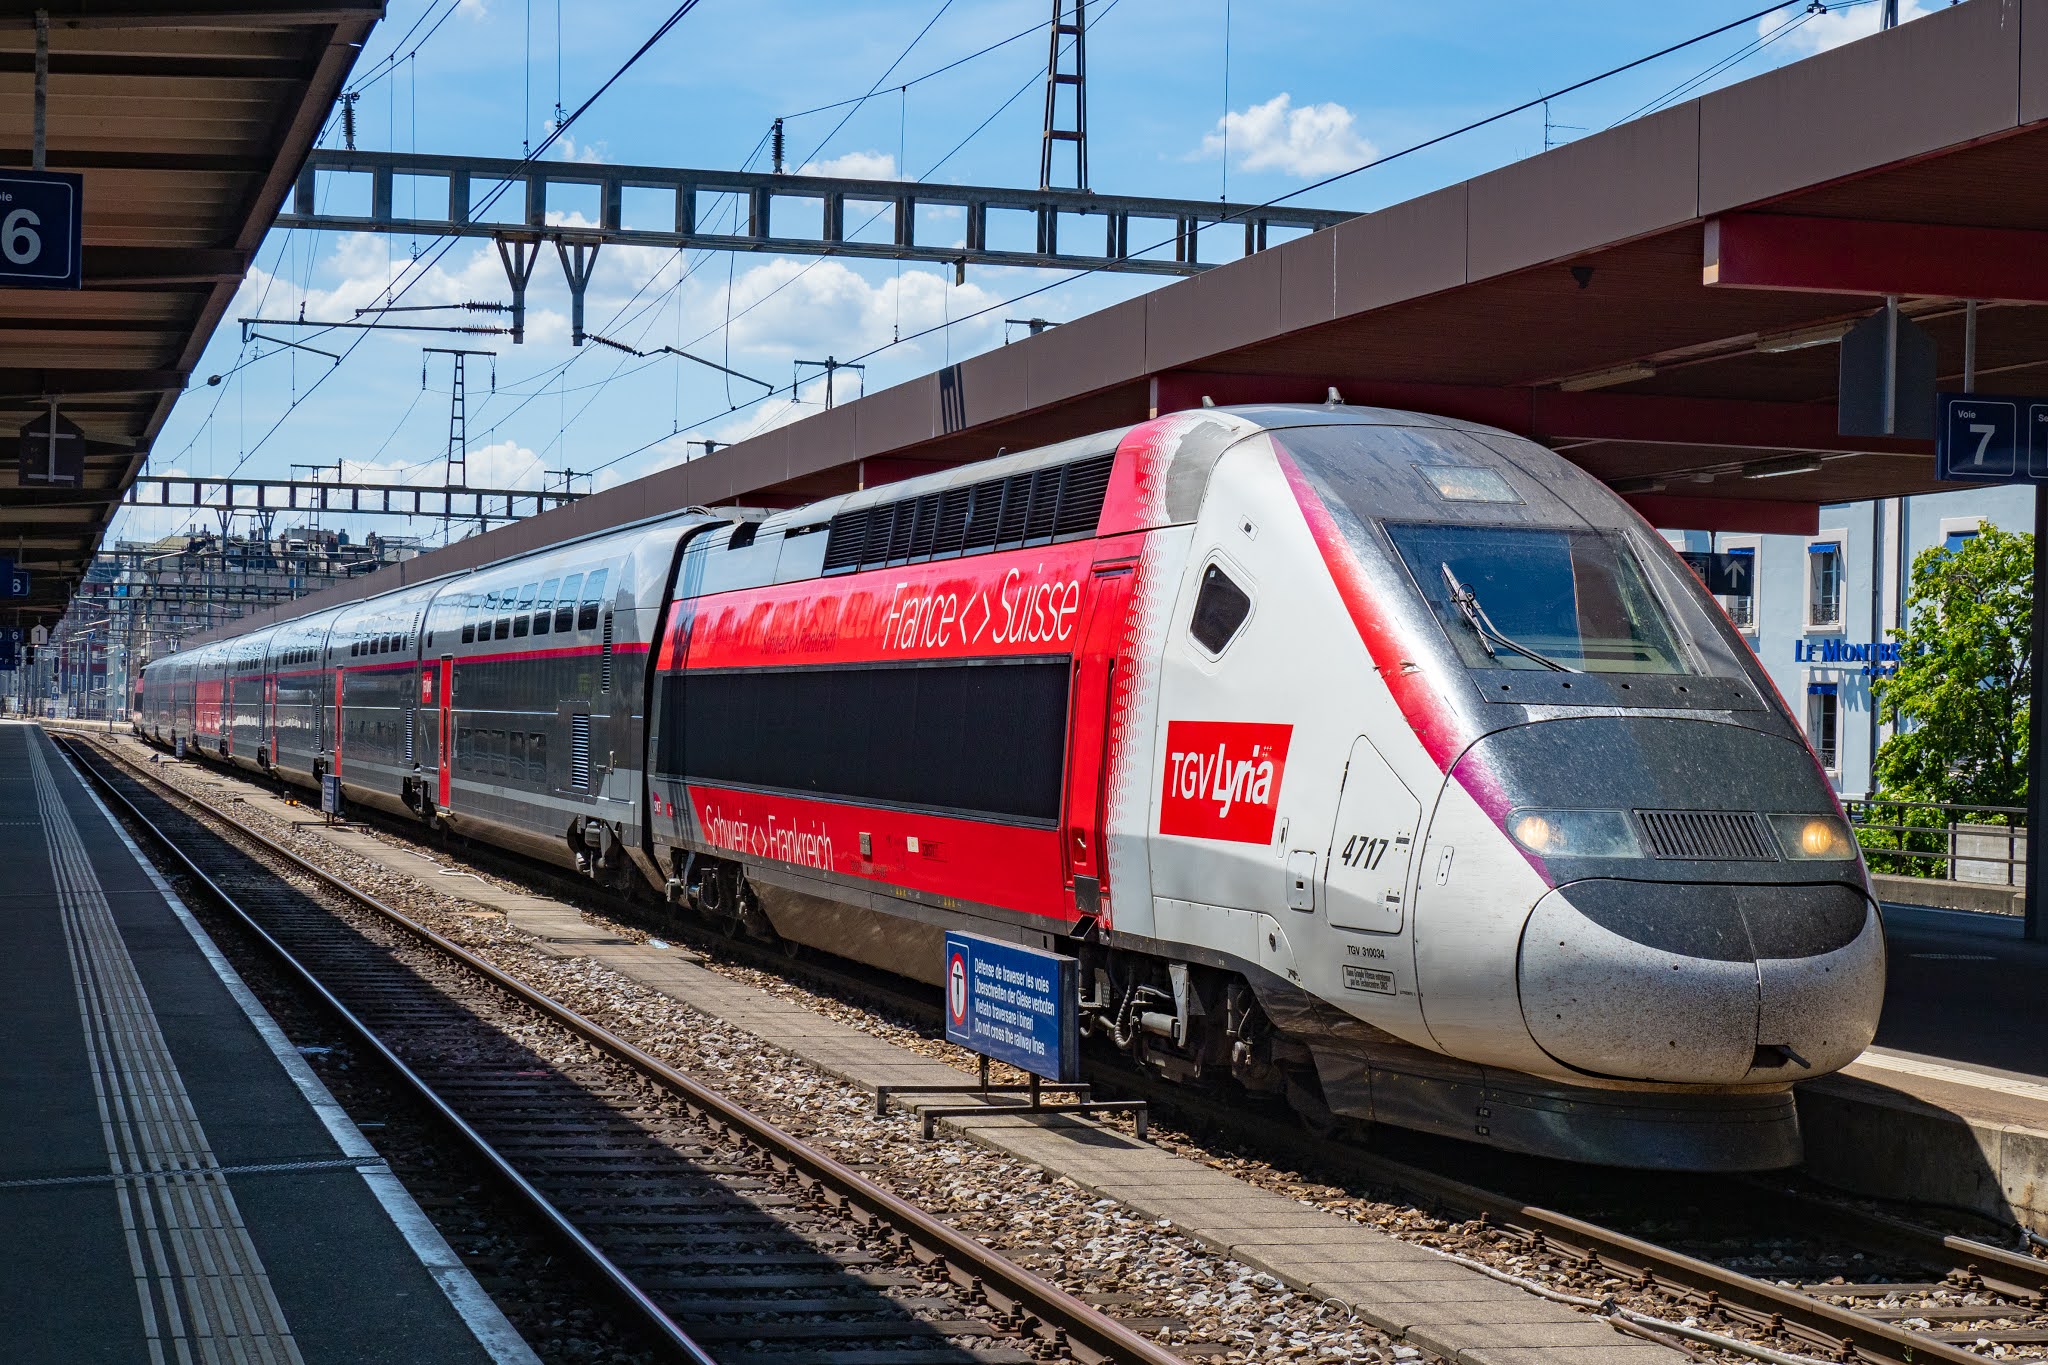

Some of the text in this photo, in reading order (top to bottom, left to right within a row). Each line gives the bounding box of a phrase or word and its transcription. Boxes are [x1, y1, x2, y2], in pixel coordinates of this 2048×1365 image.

[1, 208, 42, 265] 6
[1957, 409, 1977, 419] Voie
[1969, 423, 1996, 466] 7
[882, 582, 957, 650] France
[992, 563, 1080, 644] Suisse
[1795, 639, 1905, 663] LE MONTBR
[705, 805, 749, 853] Schweiz
[768, 815, 834, 872] Frankreich
[1341, 834, 1389, 871] 4717
[1347, 945, 1385, 959] TGV 310034
[975, 958, 1049, 993] Défense de traverser les voies
[975, 975, 1054, 1016] Überschreiten der Gleise verboten
[975, 997, 991, 1017] Vietato
[992, 1003, 1017, 1025] traversare
[1020, 1011, 1034, 1031] binari
[975, 1018, 1045, 1056] Do not cross the railway lines
